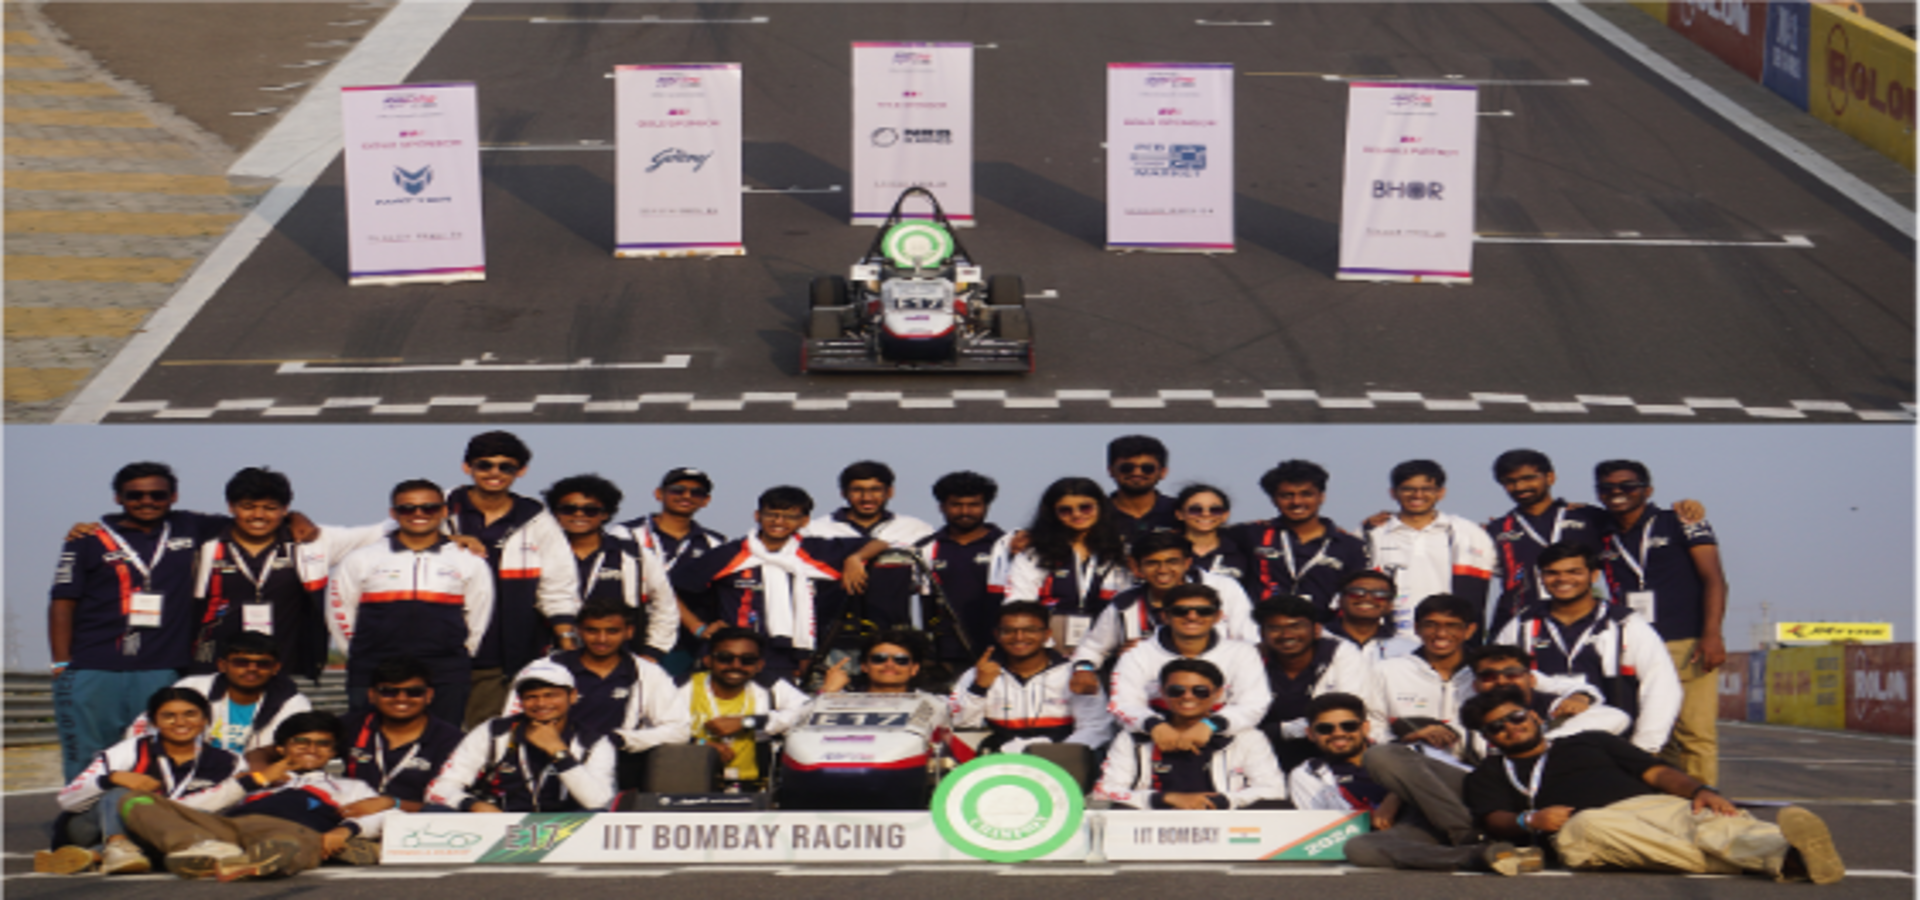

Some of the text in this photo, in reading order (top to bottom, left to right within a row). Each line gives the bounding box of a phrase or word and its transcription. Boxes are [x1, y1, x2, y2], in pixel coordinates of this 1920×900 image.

[1372, 179, 1445, 201] BHOR
[504, 823, 906, 850] E17 IIT BOMBAY RACING
[1133, 826, 1219, 844] IIT BOMBAY
[1303, 823, 1361, 857] 2024
